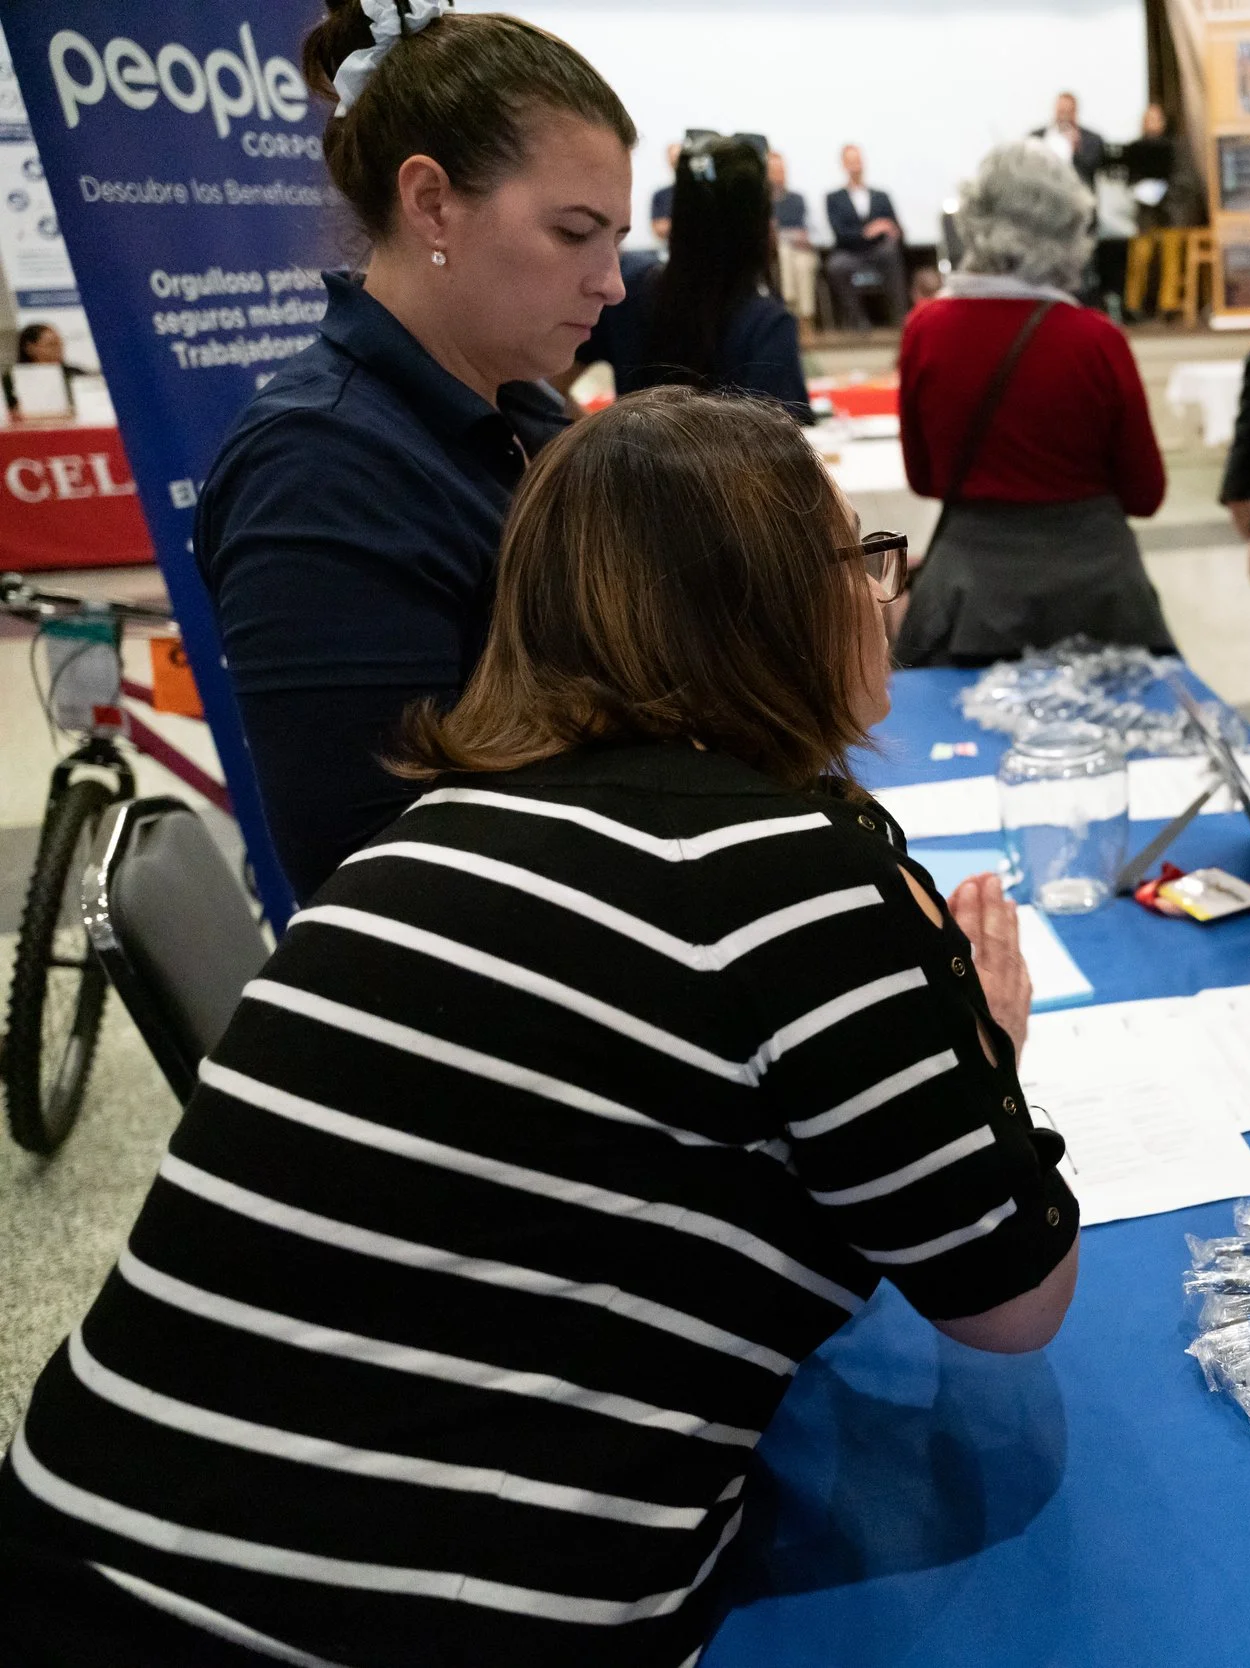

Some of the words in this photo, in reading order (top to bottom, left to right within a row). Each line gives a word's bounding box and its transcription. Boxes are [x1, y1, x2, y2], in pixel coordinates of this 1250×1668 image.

[49, 21, 308, 138] people
[79, 174, 189, 204] Descubre
[190, 177, 224, 205] los
[150, 267, 264, 301] Orgulloso
[152, 307, 247, 338] seguros
[4, 452, 137, 503] CEL
